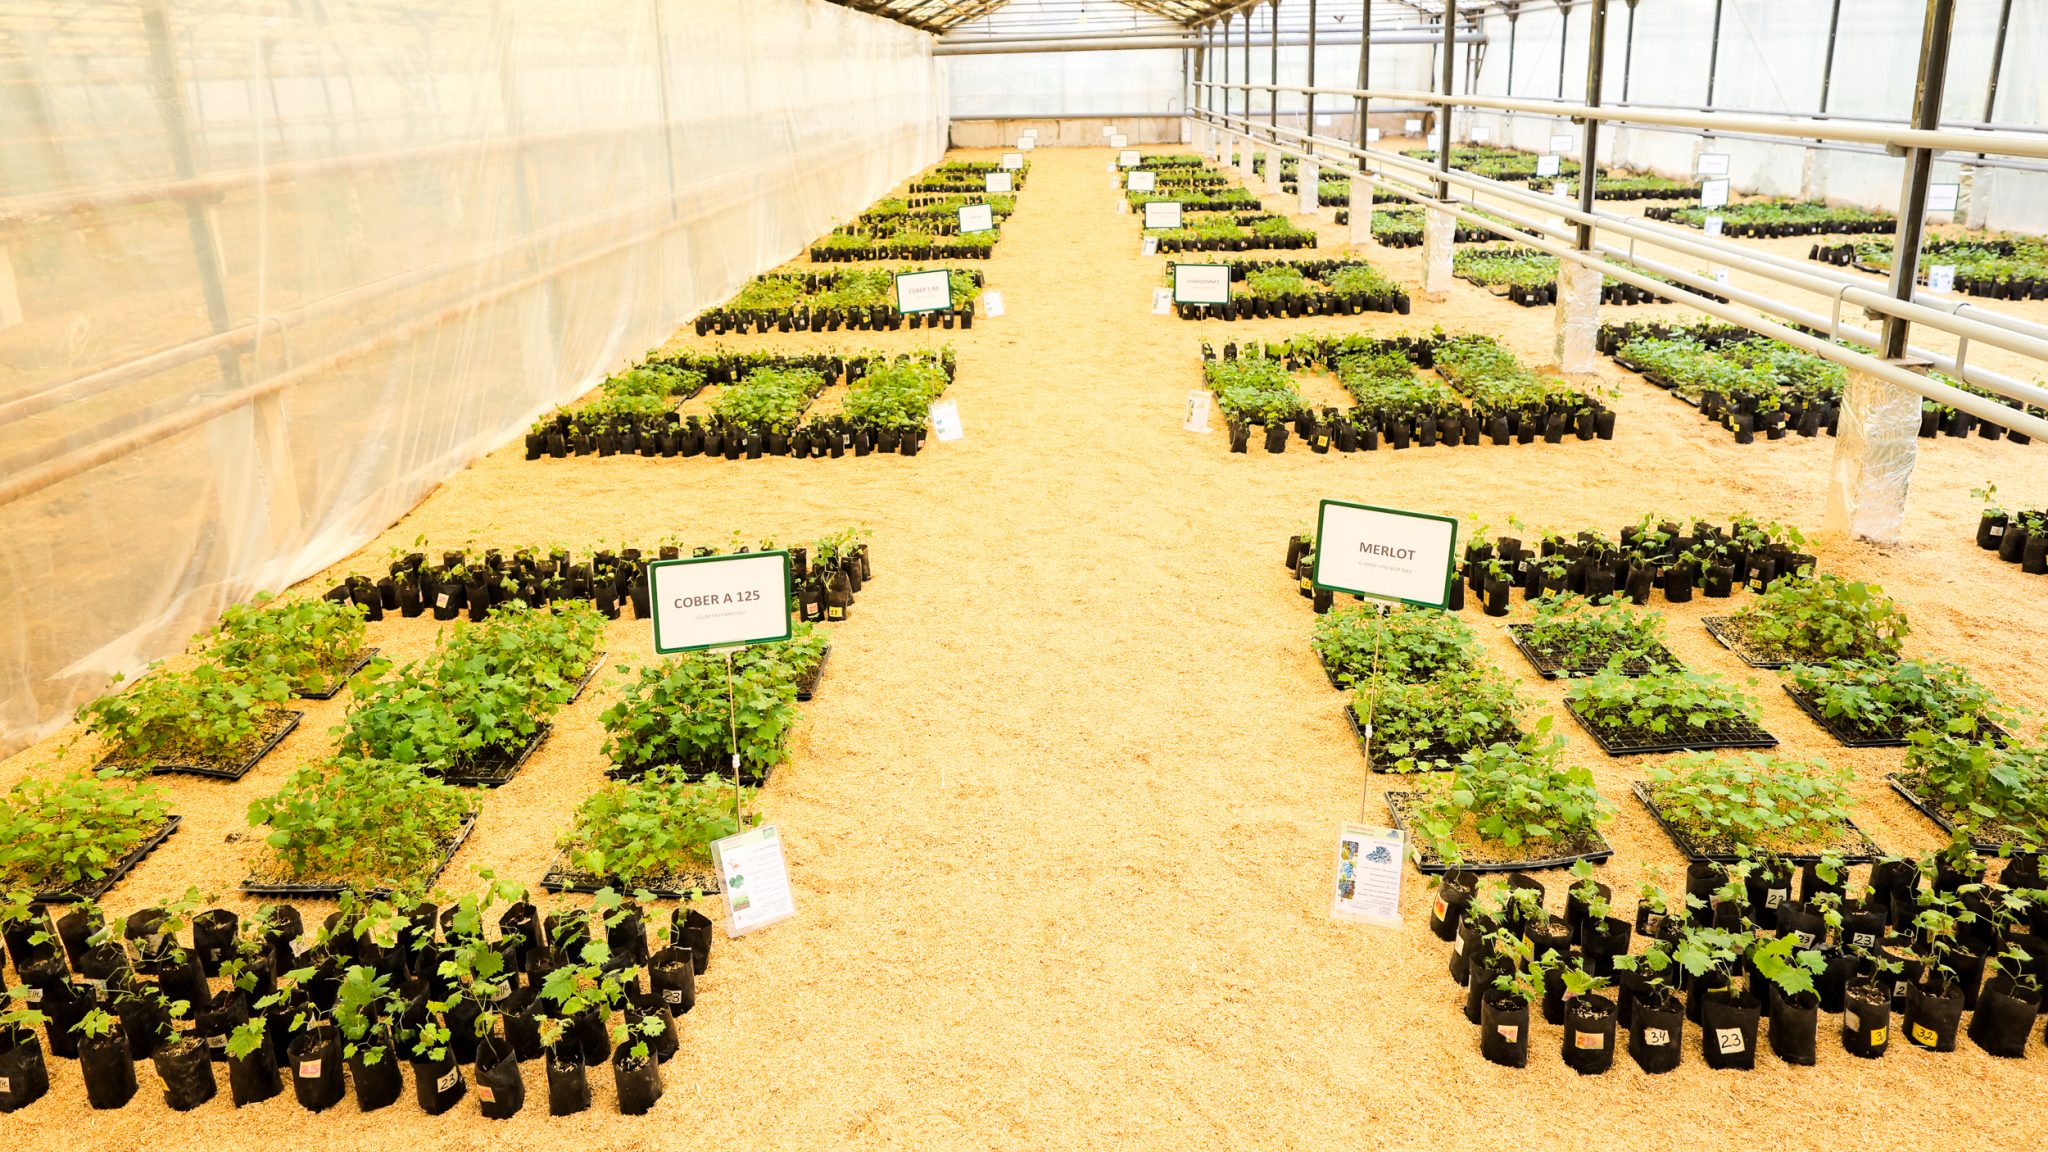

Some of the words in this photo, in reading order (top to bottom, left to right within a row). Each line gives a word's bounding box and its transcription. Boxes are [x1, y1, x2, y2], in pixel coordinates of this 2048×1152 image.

[1359, 542, 1416, 560] MERLOT
[674, 594, 720, 608] COBER
[723, 592, 733, 604] A
[737, 590, 761, 602] 125
[1854, 934, 1872, 945] 23
[663, 992, 680, 1003] 23
[1651, 1030, 1666, 1043] 34
[1721, 1034, 1742, 1048] 23
[1917, 1028, 1934, 1041] 32
[440, 1073, 455, 1090] 23
